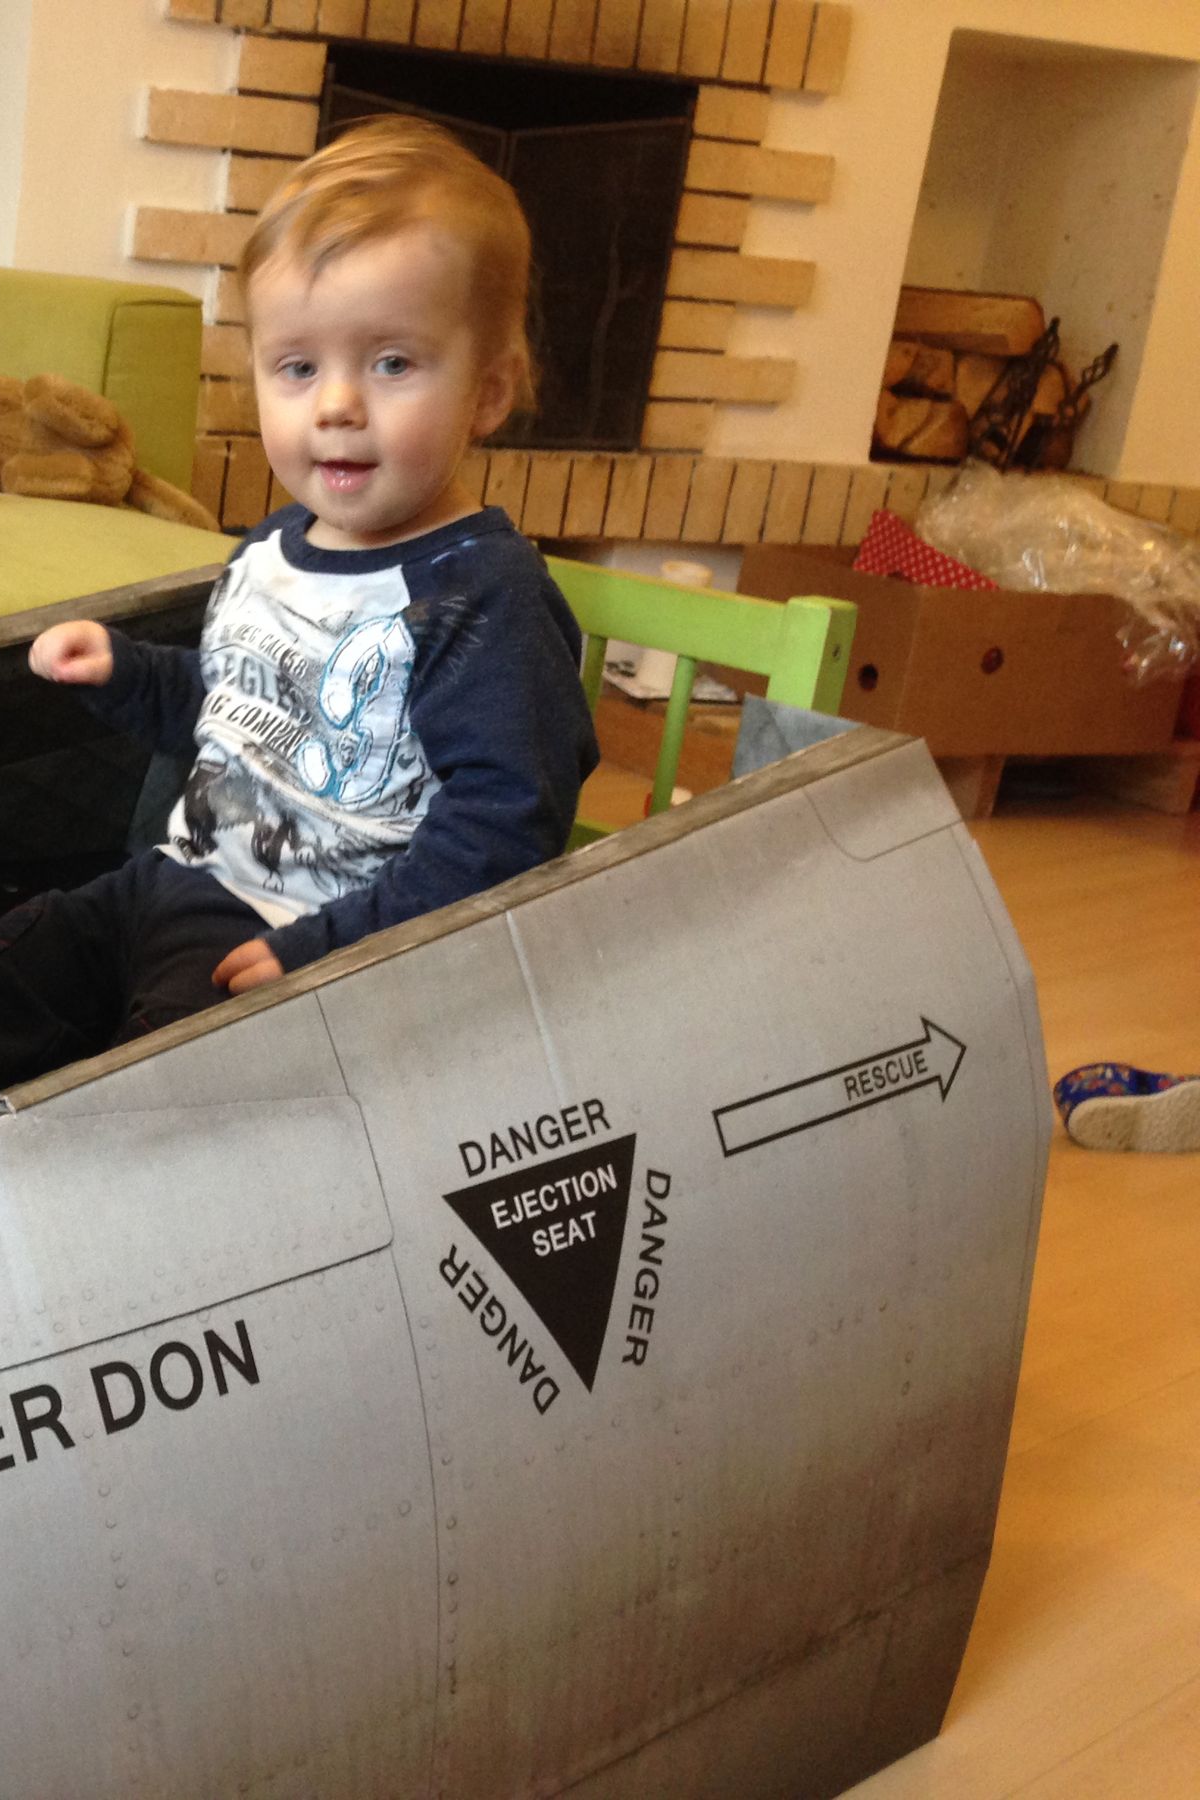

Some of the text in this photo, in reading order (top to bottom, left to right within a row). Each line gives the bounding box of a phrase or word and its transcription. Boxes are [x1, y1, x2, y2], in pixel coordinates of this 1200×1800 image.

[843, 1049, 929, 1101] RESCUE
[458, 1099, 612, 1178] DANGER
[490, 1164, 618, 1230] EJECTION
[531, 1211, 598, 1257] SEAT
[621, 1169, 672, 1367] DANGER
[438, 1244, 561, 1415] DANGER
[90, 1319, 261, 1435] DON
